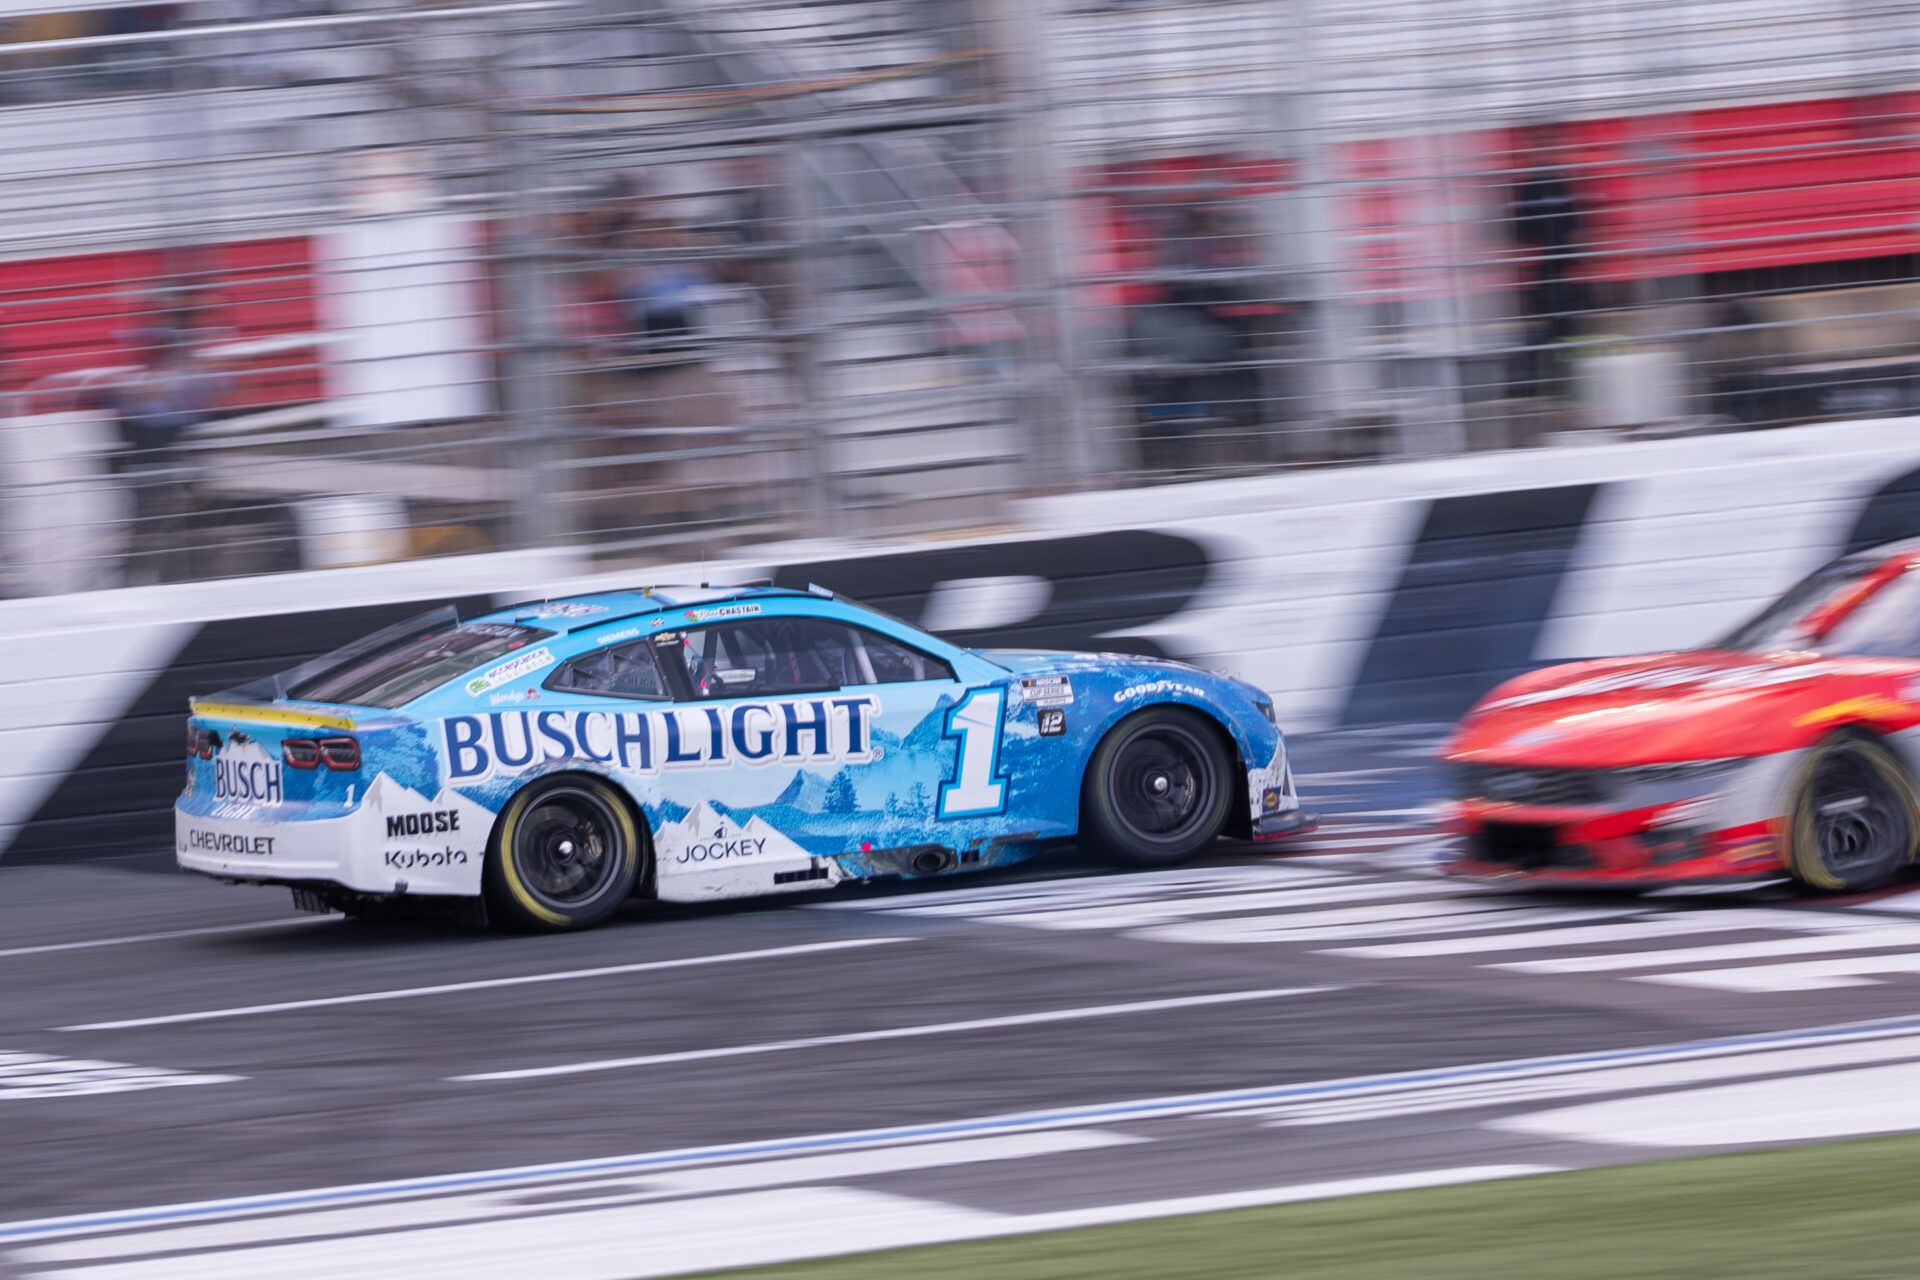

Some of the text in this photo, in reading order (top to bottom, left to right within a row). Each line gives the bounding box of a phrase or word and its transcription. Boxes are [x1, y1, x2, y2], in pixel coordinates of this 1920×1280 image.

[719, 604, 759, 617] CHASTAIN
[1029, 686, 1065, 697] CUP SERIES
[1114, 680, 1205, 704] GOODYEAR
[1040, 711, 1064, 734] 12
[442, 697, 879, 780] BUSCH LIGHT
[938, 688, 1008, 818] 1
[215, 757, 282, 804] BUSCH
[342, 783, 356, 808] 1
[386, 809, 460, 838] MOOSE
[190, 829, 275, 855] CHEVROLET
[676, 837, 766, 864] JOCKEY
[385, 846, 468, 870] Kubota
